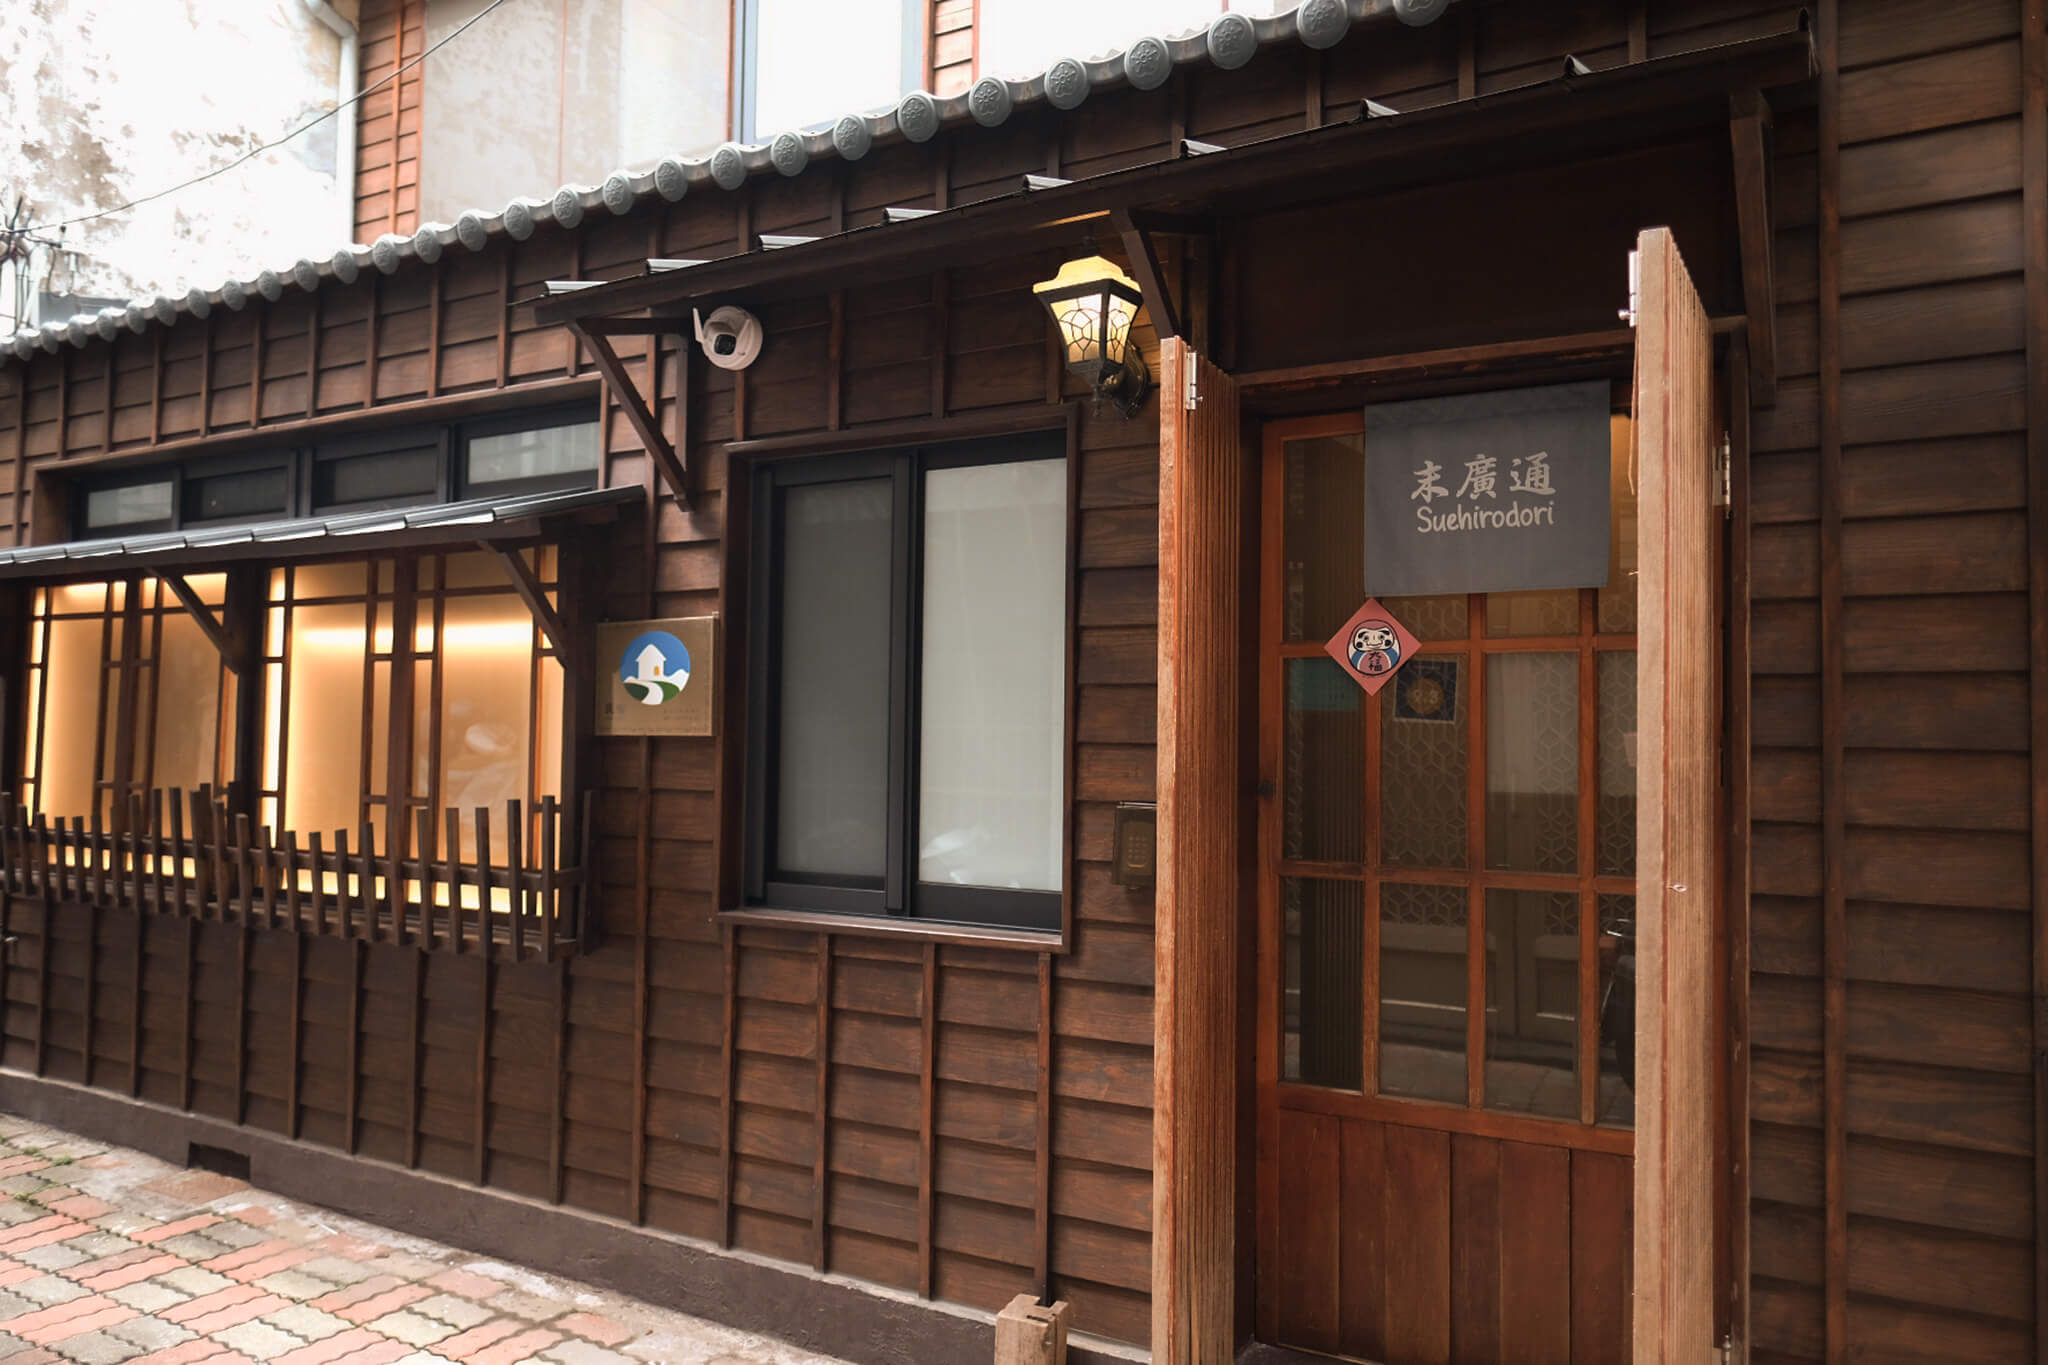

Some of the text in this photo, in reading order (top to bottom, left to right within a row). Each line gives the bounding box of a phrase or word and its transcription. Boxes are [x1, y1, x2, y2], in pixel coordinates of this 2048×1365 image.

[1410, 451, 1556, 503] 末廣通
[1416, 501, 1554, 533] Suehirodori
